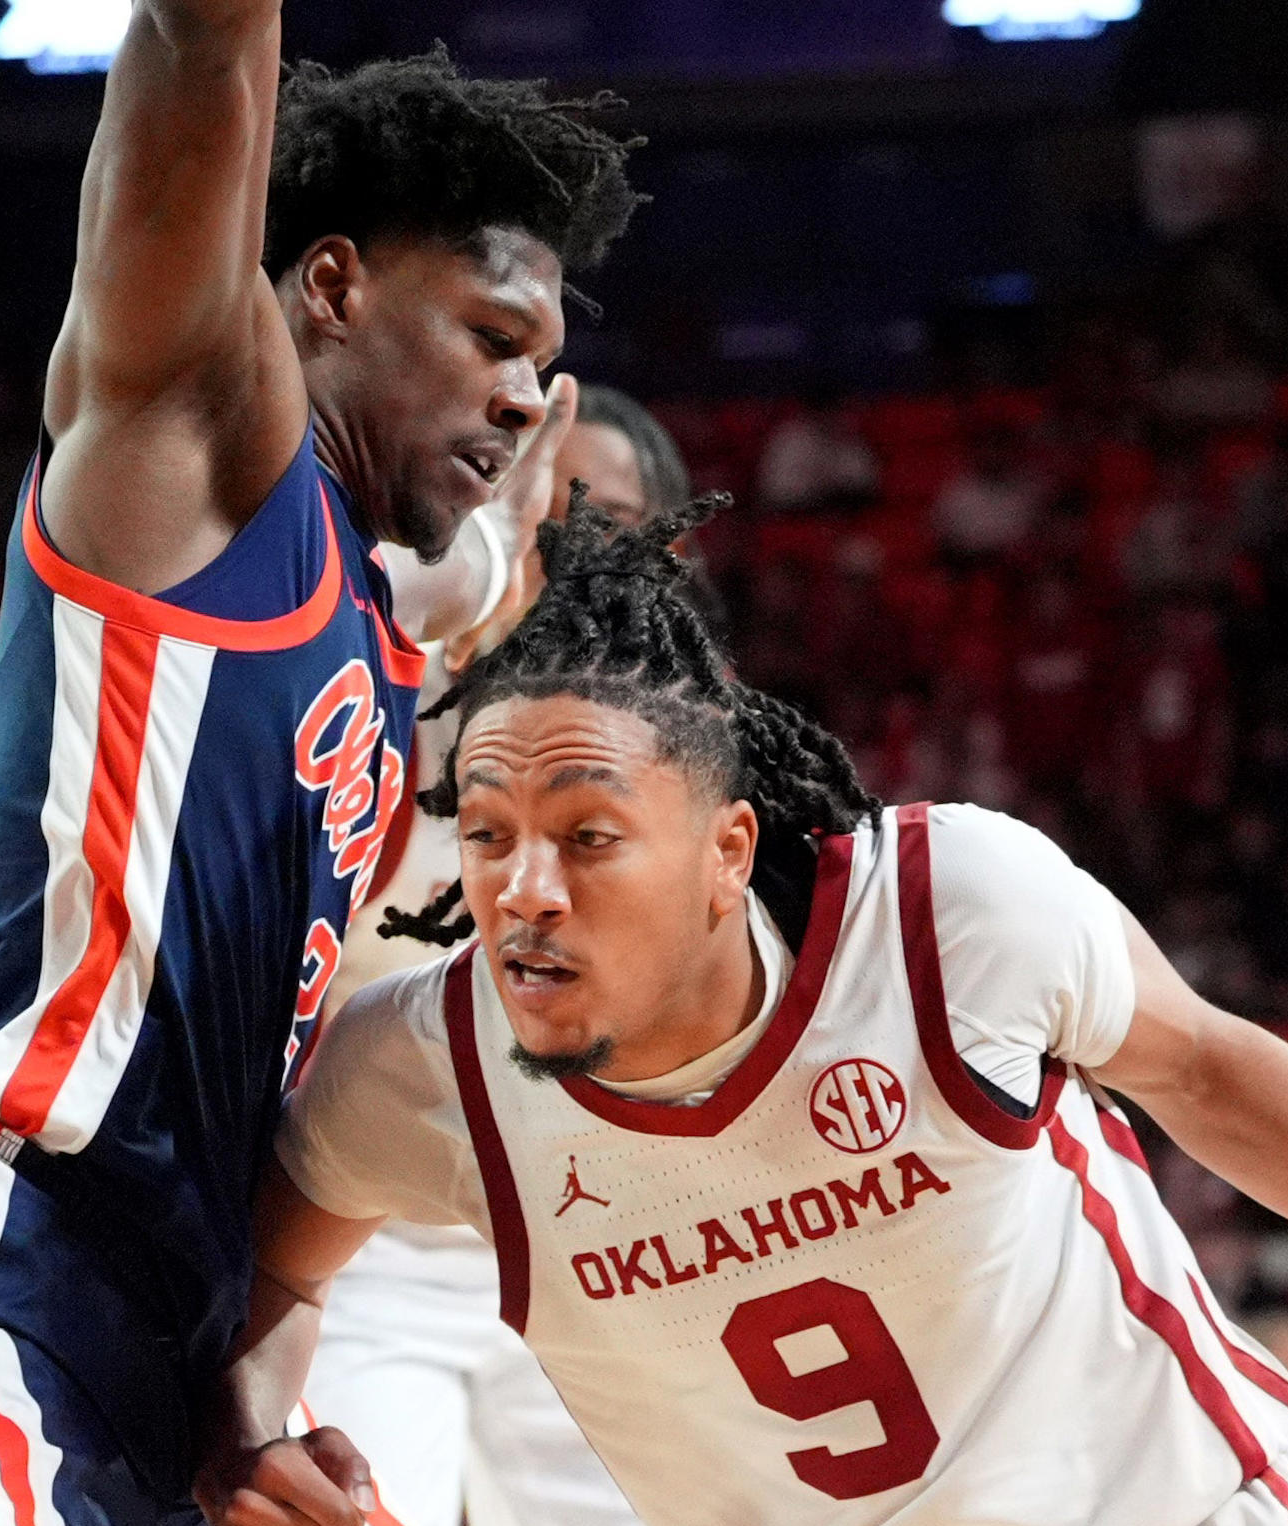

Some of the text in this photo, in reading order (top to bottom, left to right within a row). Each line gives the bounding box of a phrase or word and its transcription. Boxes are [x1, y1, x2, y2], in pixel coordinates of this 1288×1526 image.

[812, 1061, 903, 1151] SEC
[570, 1151, 952, 1301] OKLAHOMA
[720, 1276, 942, 1501] 9
